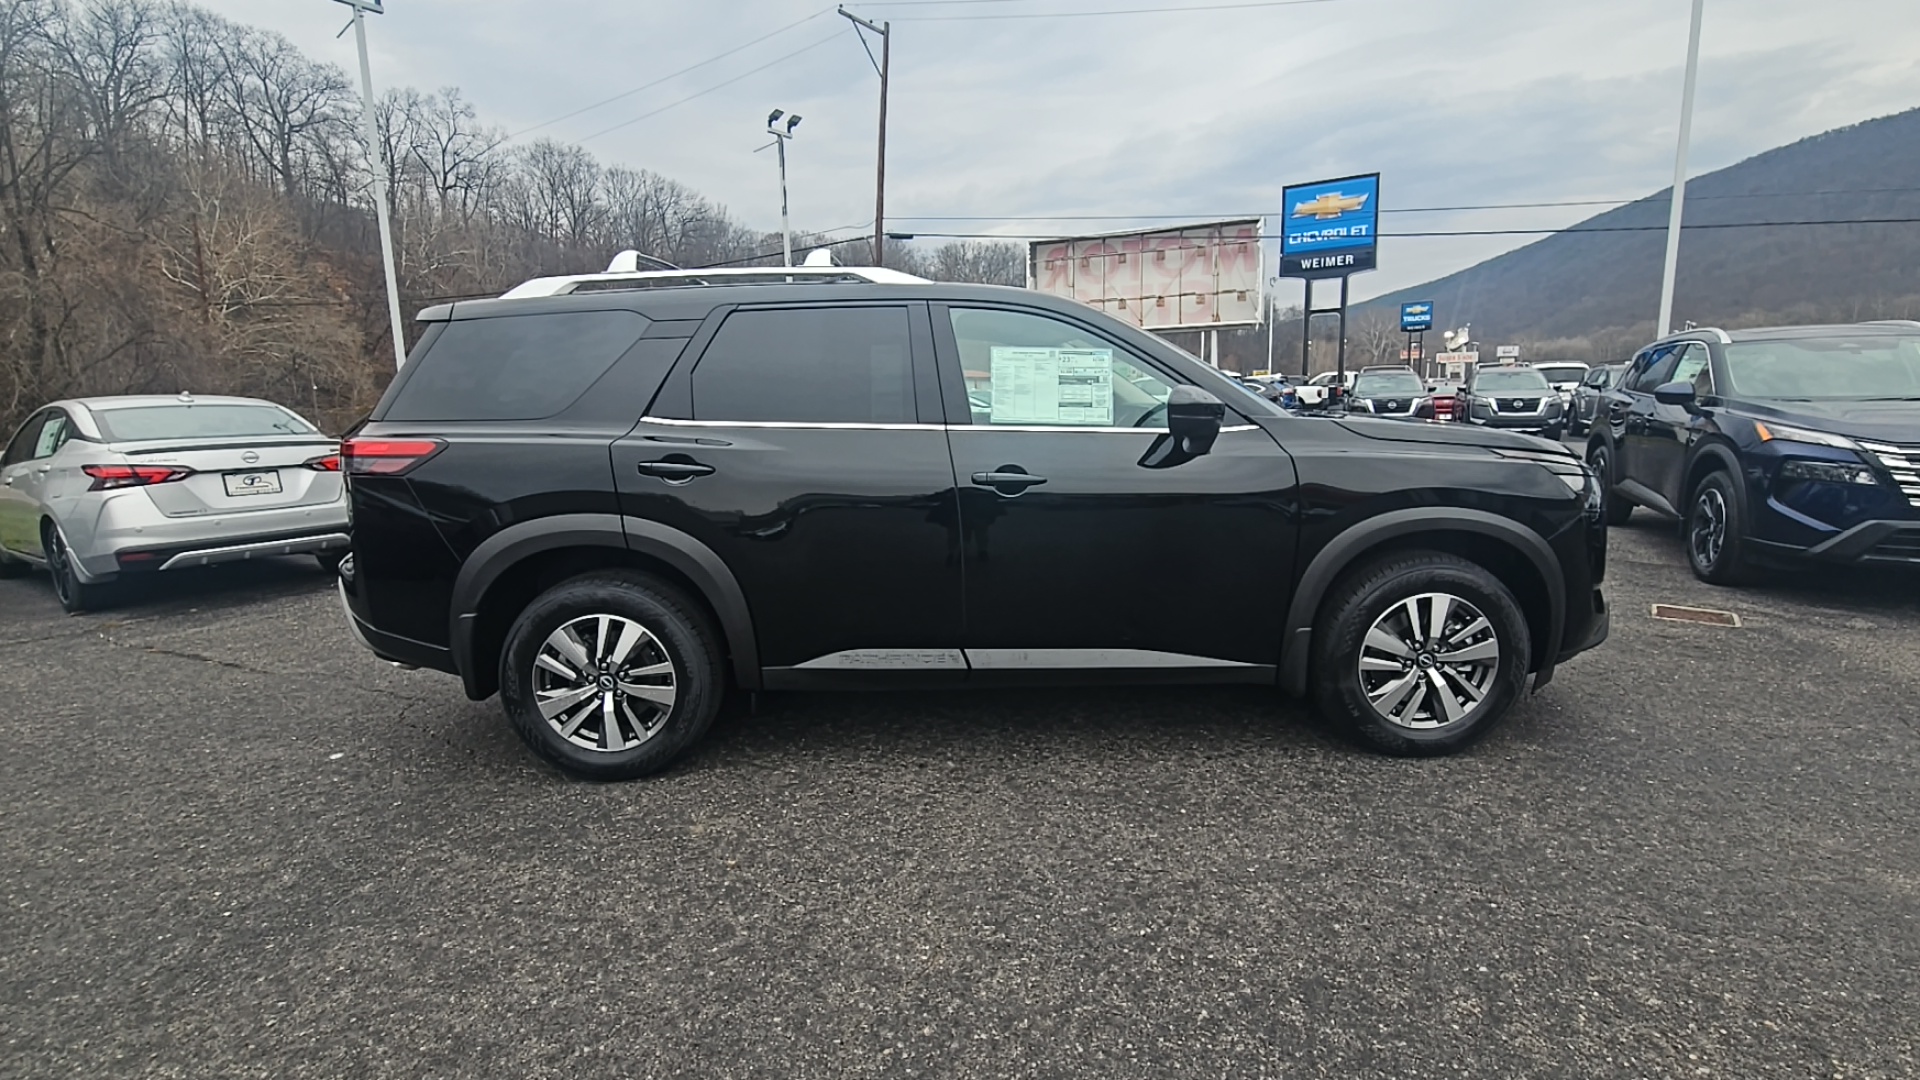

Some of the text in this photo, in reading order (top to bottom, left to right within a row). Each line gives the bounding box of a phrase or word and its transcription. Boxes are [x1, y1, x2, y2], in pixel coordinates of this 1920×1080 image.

[1289, 225, 1369, 245] CHEVROLET
[1301, 254, 1354, 270] WEIMER
[1403, 314, 1431, 323] TRUCKS
